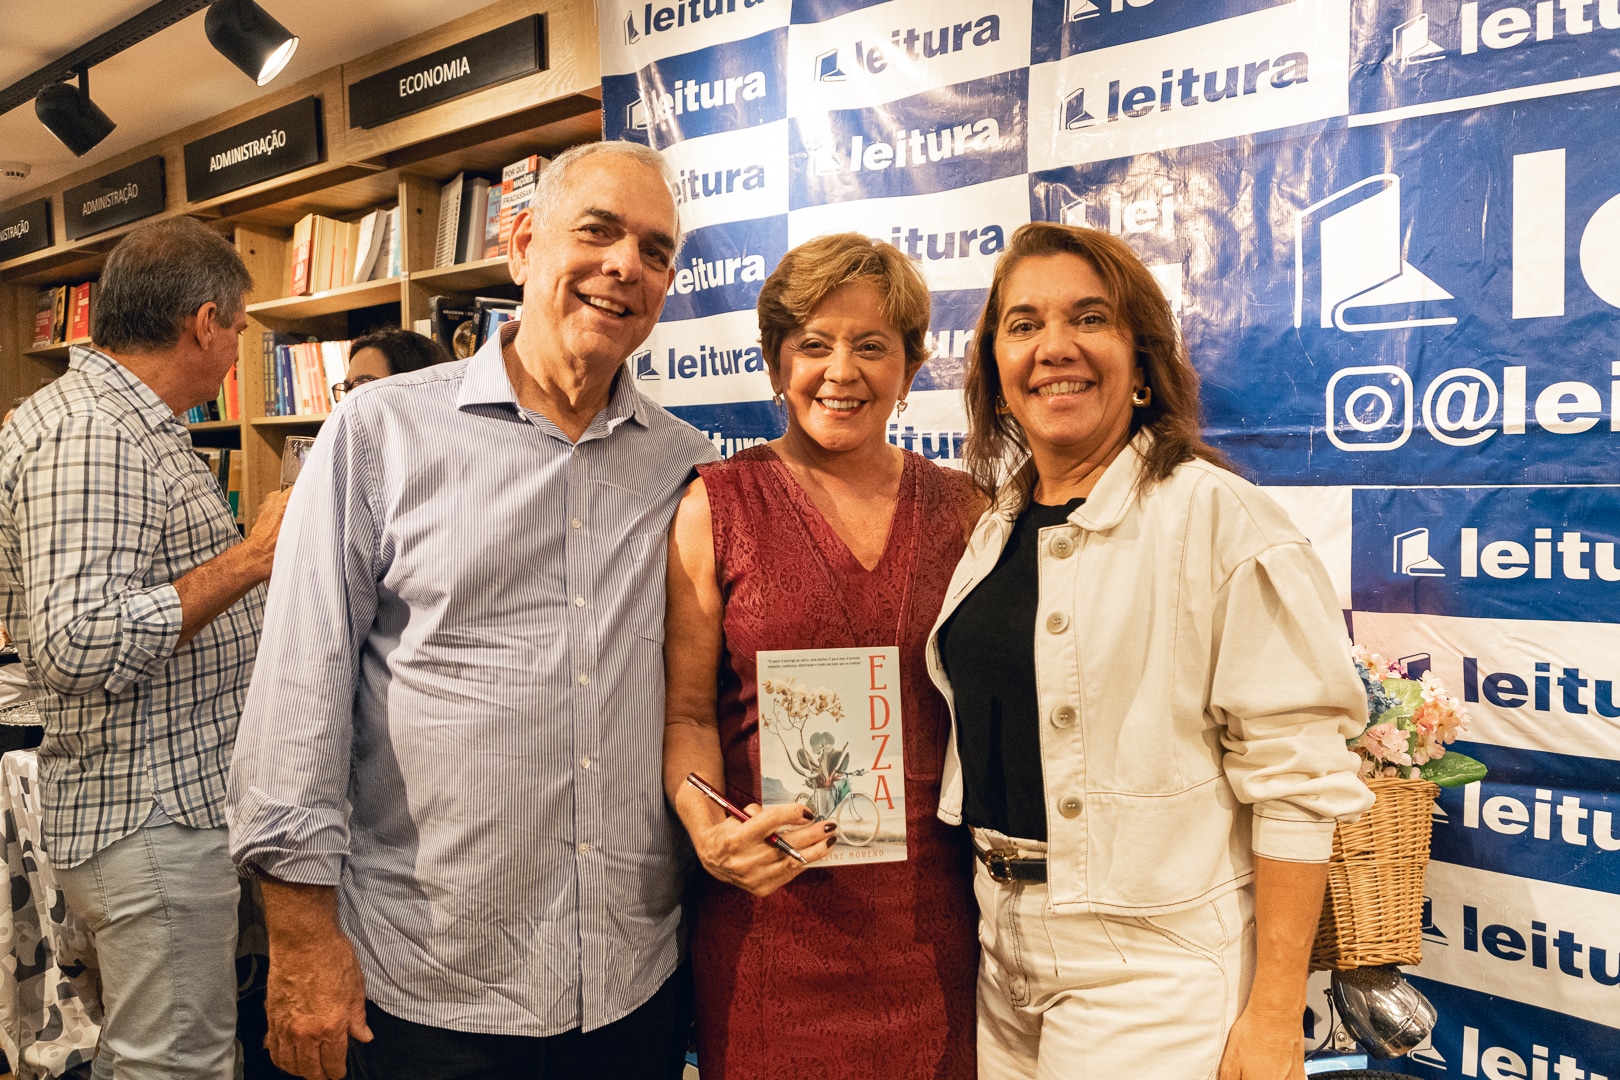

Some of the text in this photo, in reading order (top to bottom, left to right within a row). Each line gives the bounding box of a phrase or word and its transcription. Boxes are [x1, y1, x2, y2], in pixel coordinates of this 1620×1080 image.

[400, 56, 471, 97] ECONOMIA
[651, 70, 766, 123] leitura
[1107, 51, 1309, 122] leitura
[209, 129, 287, 172] ADMINISTRAÇÃO
[850, 117, 1000, 172] leitura
[82, 182, 139, 216] ADMINISTRAÇÃO
[672, 164, 765, 206] itura
[668, 344, 765, 379] leitura
[849, 850, 884, 860] MORENO
[1461, 1025, 1608, 1080] leit
